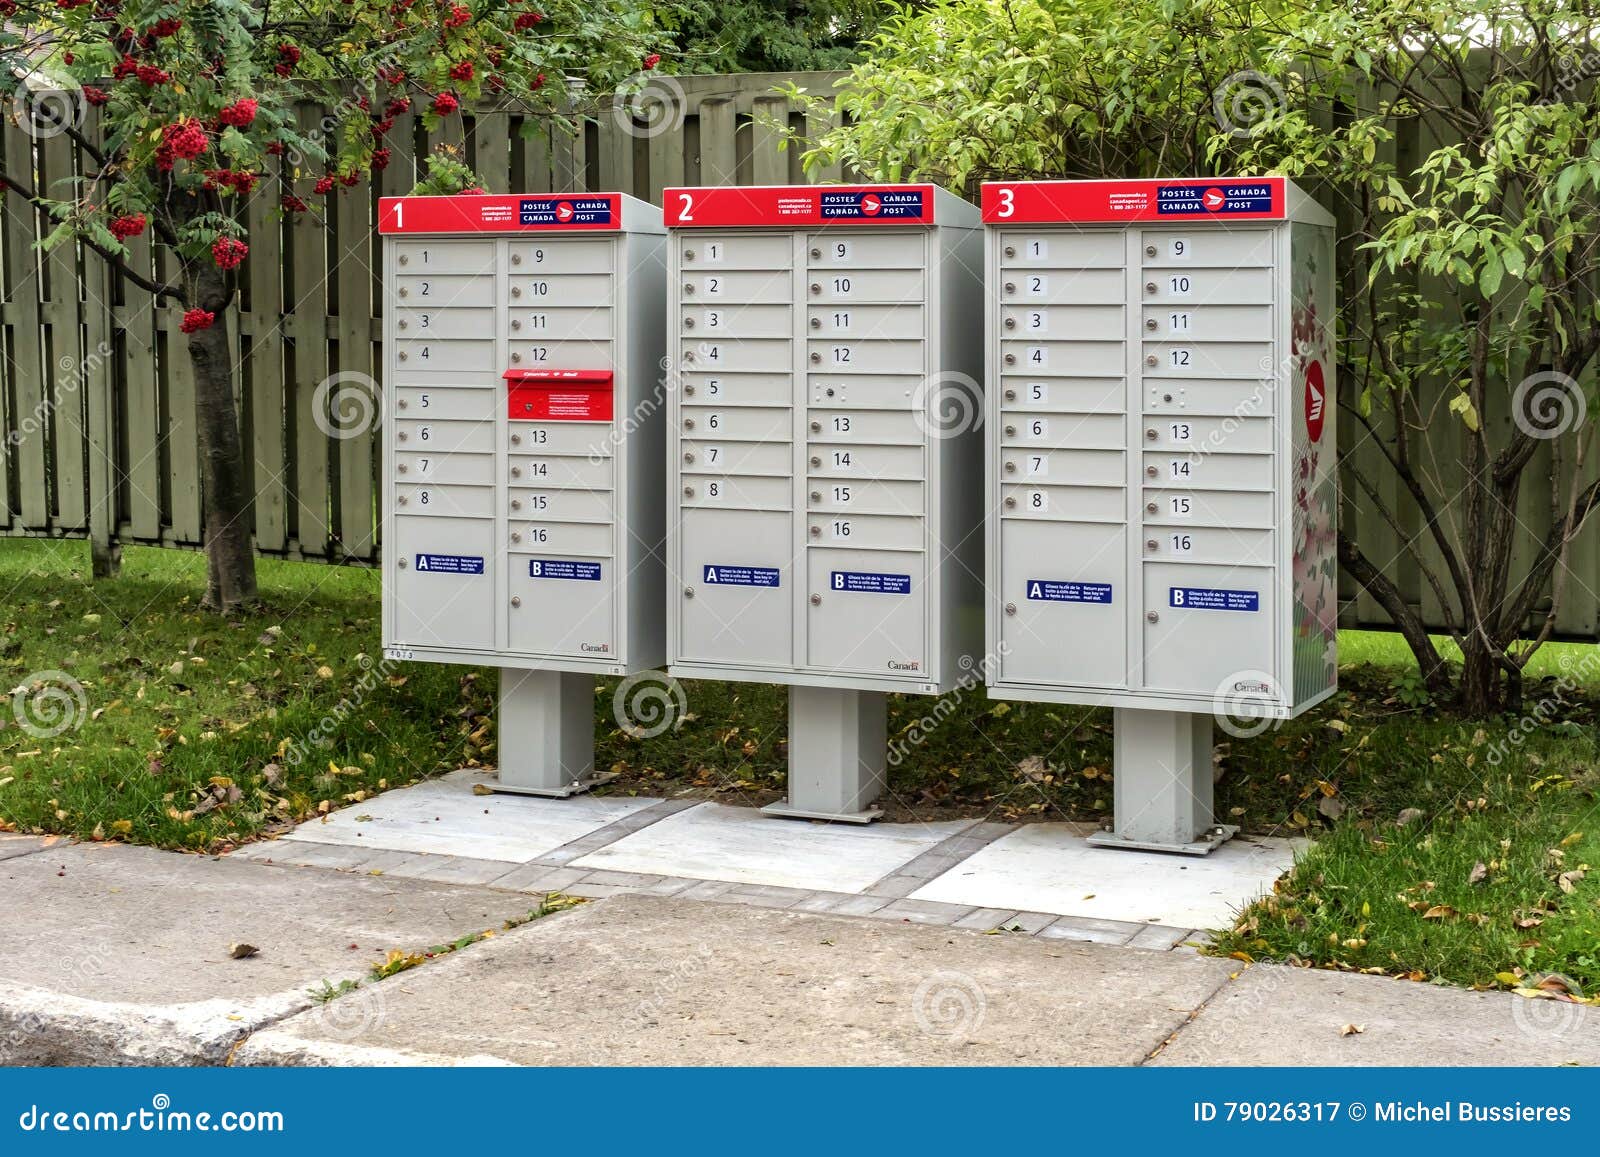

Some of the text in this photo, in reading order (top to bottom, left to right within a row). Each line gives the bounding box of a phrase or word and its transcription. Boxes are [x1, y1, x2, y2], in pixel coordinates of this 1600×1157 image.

[1228, 188, 1267, 196] CANADA
[678, 194, 693, 221] 2
[998, 189, 1014, 217] 3
[393, 202, 403, 228] 1
[711, 245, 716, 259] 1
[837, 243, 846, 258] 9
[1033, 241, 1039, 256] 1
[1174, 240, 1184, 256] 9
[423, 250, 428, 263] 1
[535, 249, 544, 263] 9
[421, 282, 429, 296] 2
[533, 282, 548, 296] 10
[710, 279, 718, 293] 2
[834, 278, 851, 293] 10
[1032, 277, 1041, 292] 2
[1171, 277, 1189, 293] 10
[421, 314, 429, 328] 3
[533, 315, 545, 328] 11
[710, 312, 718, 327] 3
[834, 313, 849, 327] 11
[1032, 313, 1041, 328] 3
[1171, 314, 1187, 329] 11
[421, 346, 430, 359] 4
[532, 347, 547, 361] 12
[709, 346, 718, 360] 4
[834, 348, 850, 362] 12
[1032, 349, 1042, 364] 4
[1172, 350, 1189, 366] 12
[710, 380, 718, 395] 5
[1033, 385, 1042, 400] 5
[422, 395, 429, 408] 5
[709, 414, 718, 429] 6
[834, 417, 850, 432] 13
[1032, 421, 1042, 436] 6
[421, 427, 429, 441] 6
[532, 430, 547, 444] 13
[1172, 424, 1189, 440] 13
[710, 448, 718, 463] 7
[834, 452, 851, 466] 14
[421, 459, 429, 472] 7
[532, 463, 547, 477] 14
[1032, 457, 1041, 472] 7
[1172, 461, 1190, 476] 14
[709, 482, 718, 497] 8
[834, 487, 850, 502] 15
[421, 491, 429, 505] 8
[532, 496, 547, 510] 15
[1032, 493, 1042, 508] 8
[1172, 498, 1190, 513] 15
[532, 528, 547, 543] 16
[834, 522, 851, 536] 16
[1173, 535, 1191, 550] 16
[418, 555, 428, 569] A
[533, 562, 541, 576] B
[706, 567, 718, 582] A
[835, 574, 844, 589] B
[1030, 582, 1042, 598] A
[1174, 589, 1184, 605] B
[581, 642, 608, 653] Canada
[887, 660, 919, 671] Canada
[1234, 682, 1269, 693] Canada
